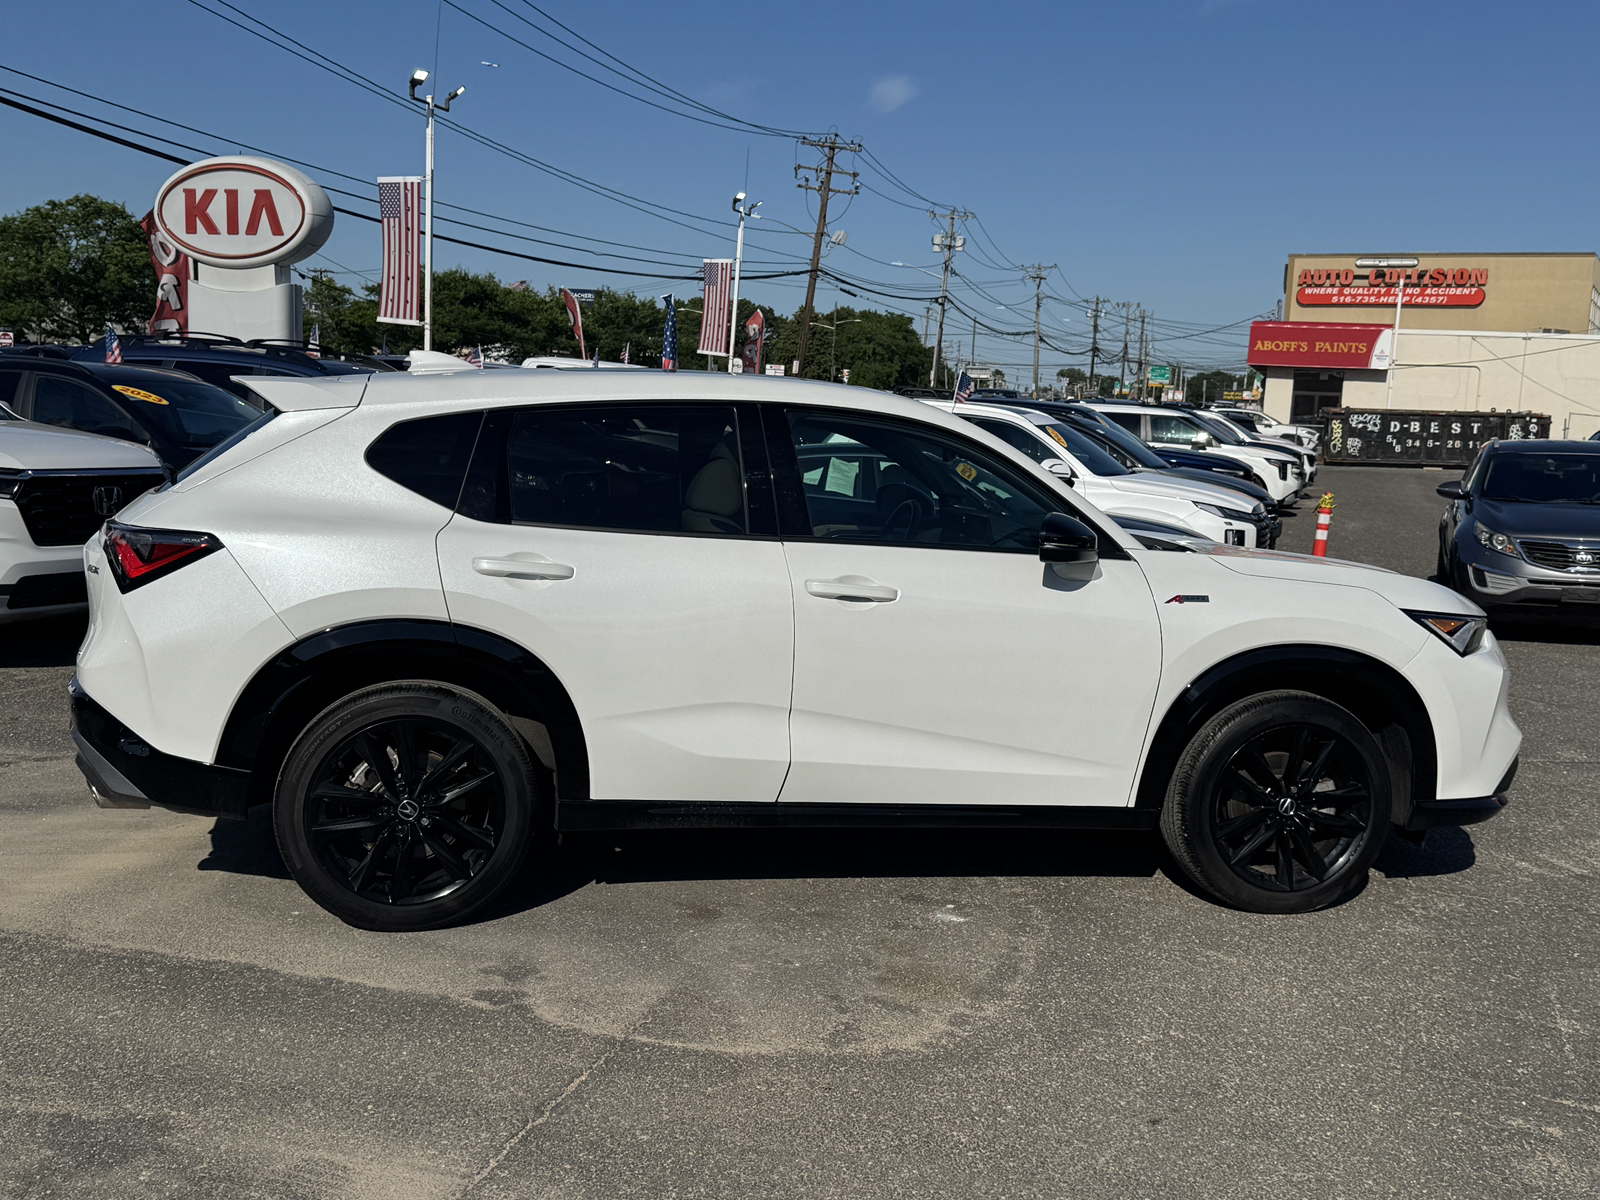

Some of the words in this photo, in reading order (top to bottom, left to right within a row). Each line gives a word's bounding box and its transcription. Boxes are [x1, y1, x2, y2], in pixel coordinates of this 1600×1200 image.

[183, 188, 284, 236] KIA
[1297, 269, 1355, 286] AUTO
[1369, 268, 1488, 286] COLLISION
[1305, 287, 1339, 295] WHERE
[1343, 287, 1386, 295] QUALITY
[1405, 287, 1420, 295] NO
[1424, 287, 1478, 295] ACCIDENT
[1411, 295, 1448, 304] (4357)
[1254, 340, 1308, 353] ABOFF'S
[1315, 341, 1367, 354] PAINTS
[450, 705, 501, 743] Continental
